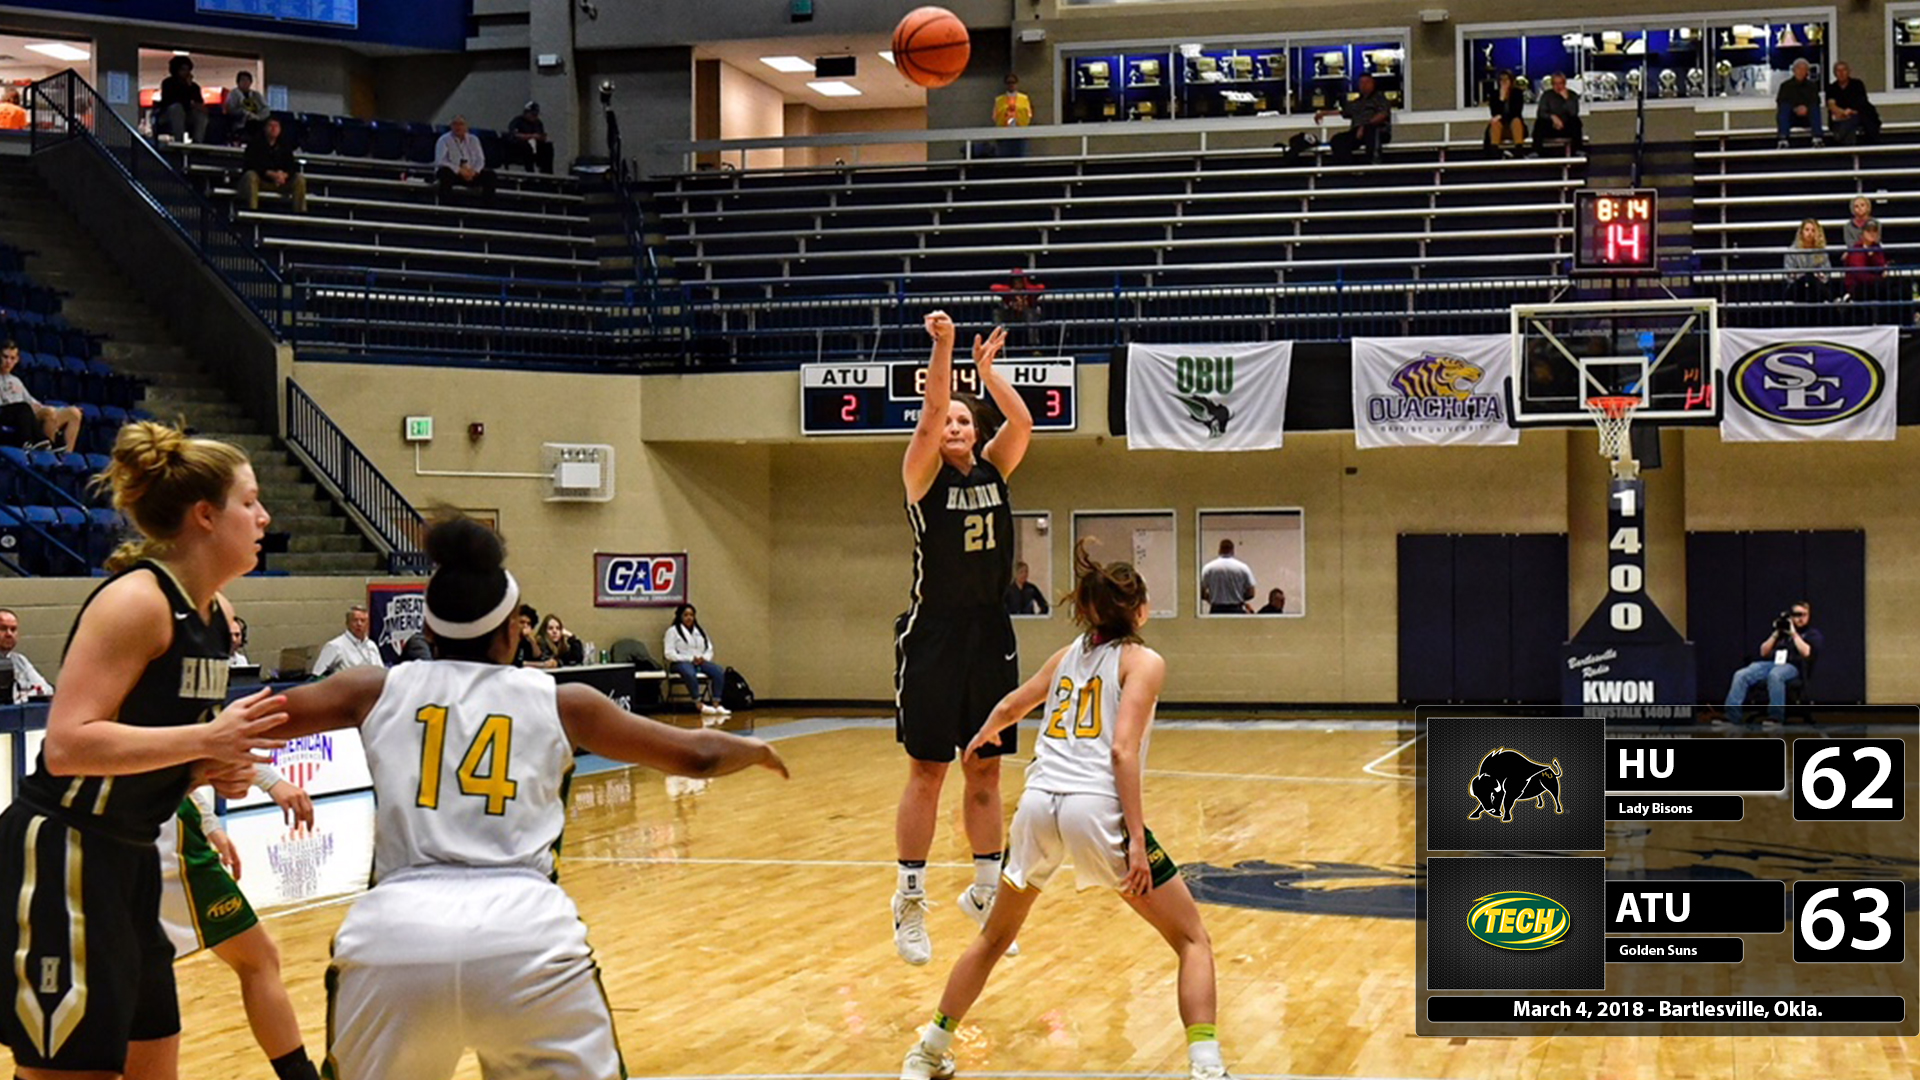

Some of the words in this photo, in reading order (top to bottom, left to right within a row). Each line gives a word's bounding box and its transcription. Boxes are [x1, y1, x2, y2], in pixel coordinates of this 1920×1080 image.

[1597, 198, 1649, 222] 8:14
[1608, 224, 1639, 260] 14
[821, 369, 868, 385] ATU
[1014, 367, 1047, 384] HU
[1176, 356, 1235, 395] OBU
[841, 394, 857, 422] 2
[1046, 390, 1061, 418] 3
[1369, 394, 1503, 423] OUACHITA
[964, 511, 997, 552] 21
[605, 557, 676, 594] GAC
[1582, 664, 1610, 679] Radio
[1583, 680, 1655, 704] KWON
[1044, 674, 1103, 740] 20
[1583, 706, 1642, 719] NEWSTALK
[1643, 706, 1673, 719] 1400
[1673, 706, 1693, 719] AM
[415, 703, 518, 817] 14
